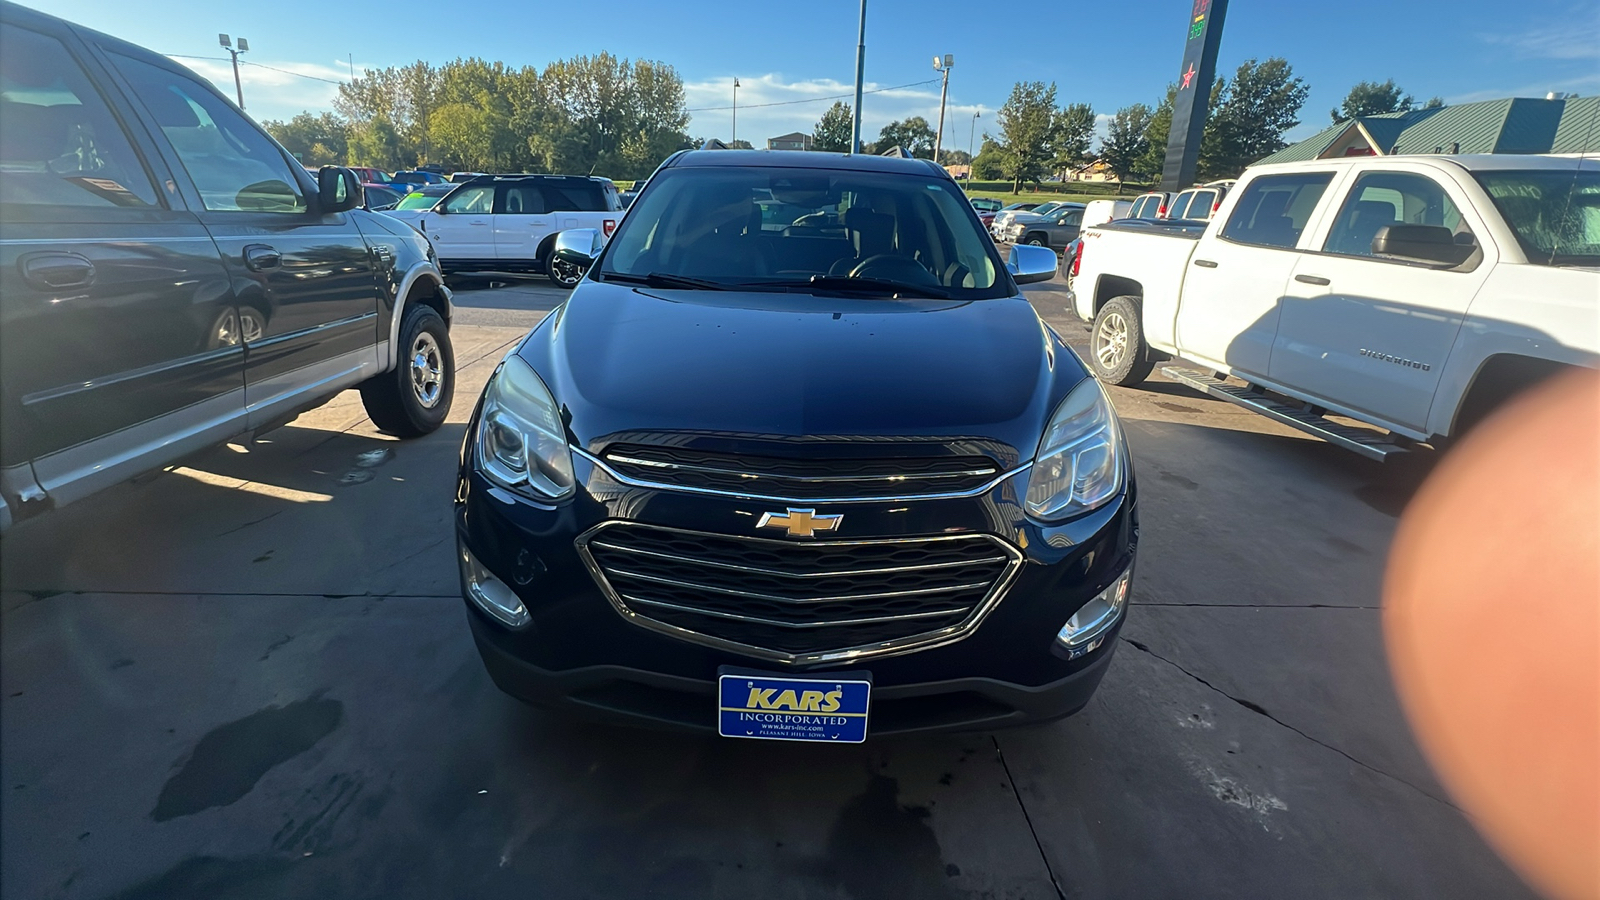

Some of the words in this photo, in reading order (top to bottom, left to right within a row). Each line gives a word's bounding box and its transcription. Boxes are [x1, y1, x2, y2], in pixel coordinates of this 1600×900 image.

[1360, 348, 1431, 371] SILVERADO
[746, 688, 843, 712] KARS
[740, 713, 847, 725] INCORPORATED
[761, 723, 824, 732] www.kars-inc.com
